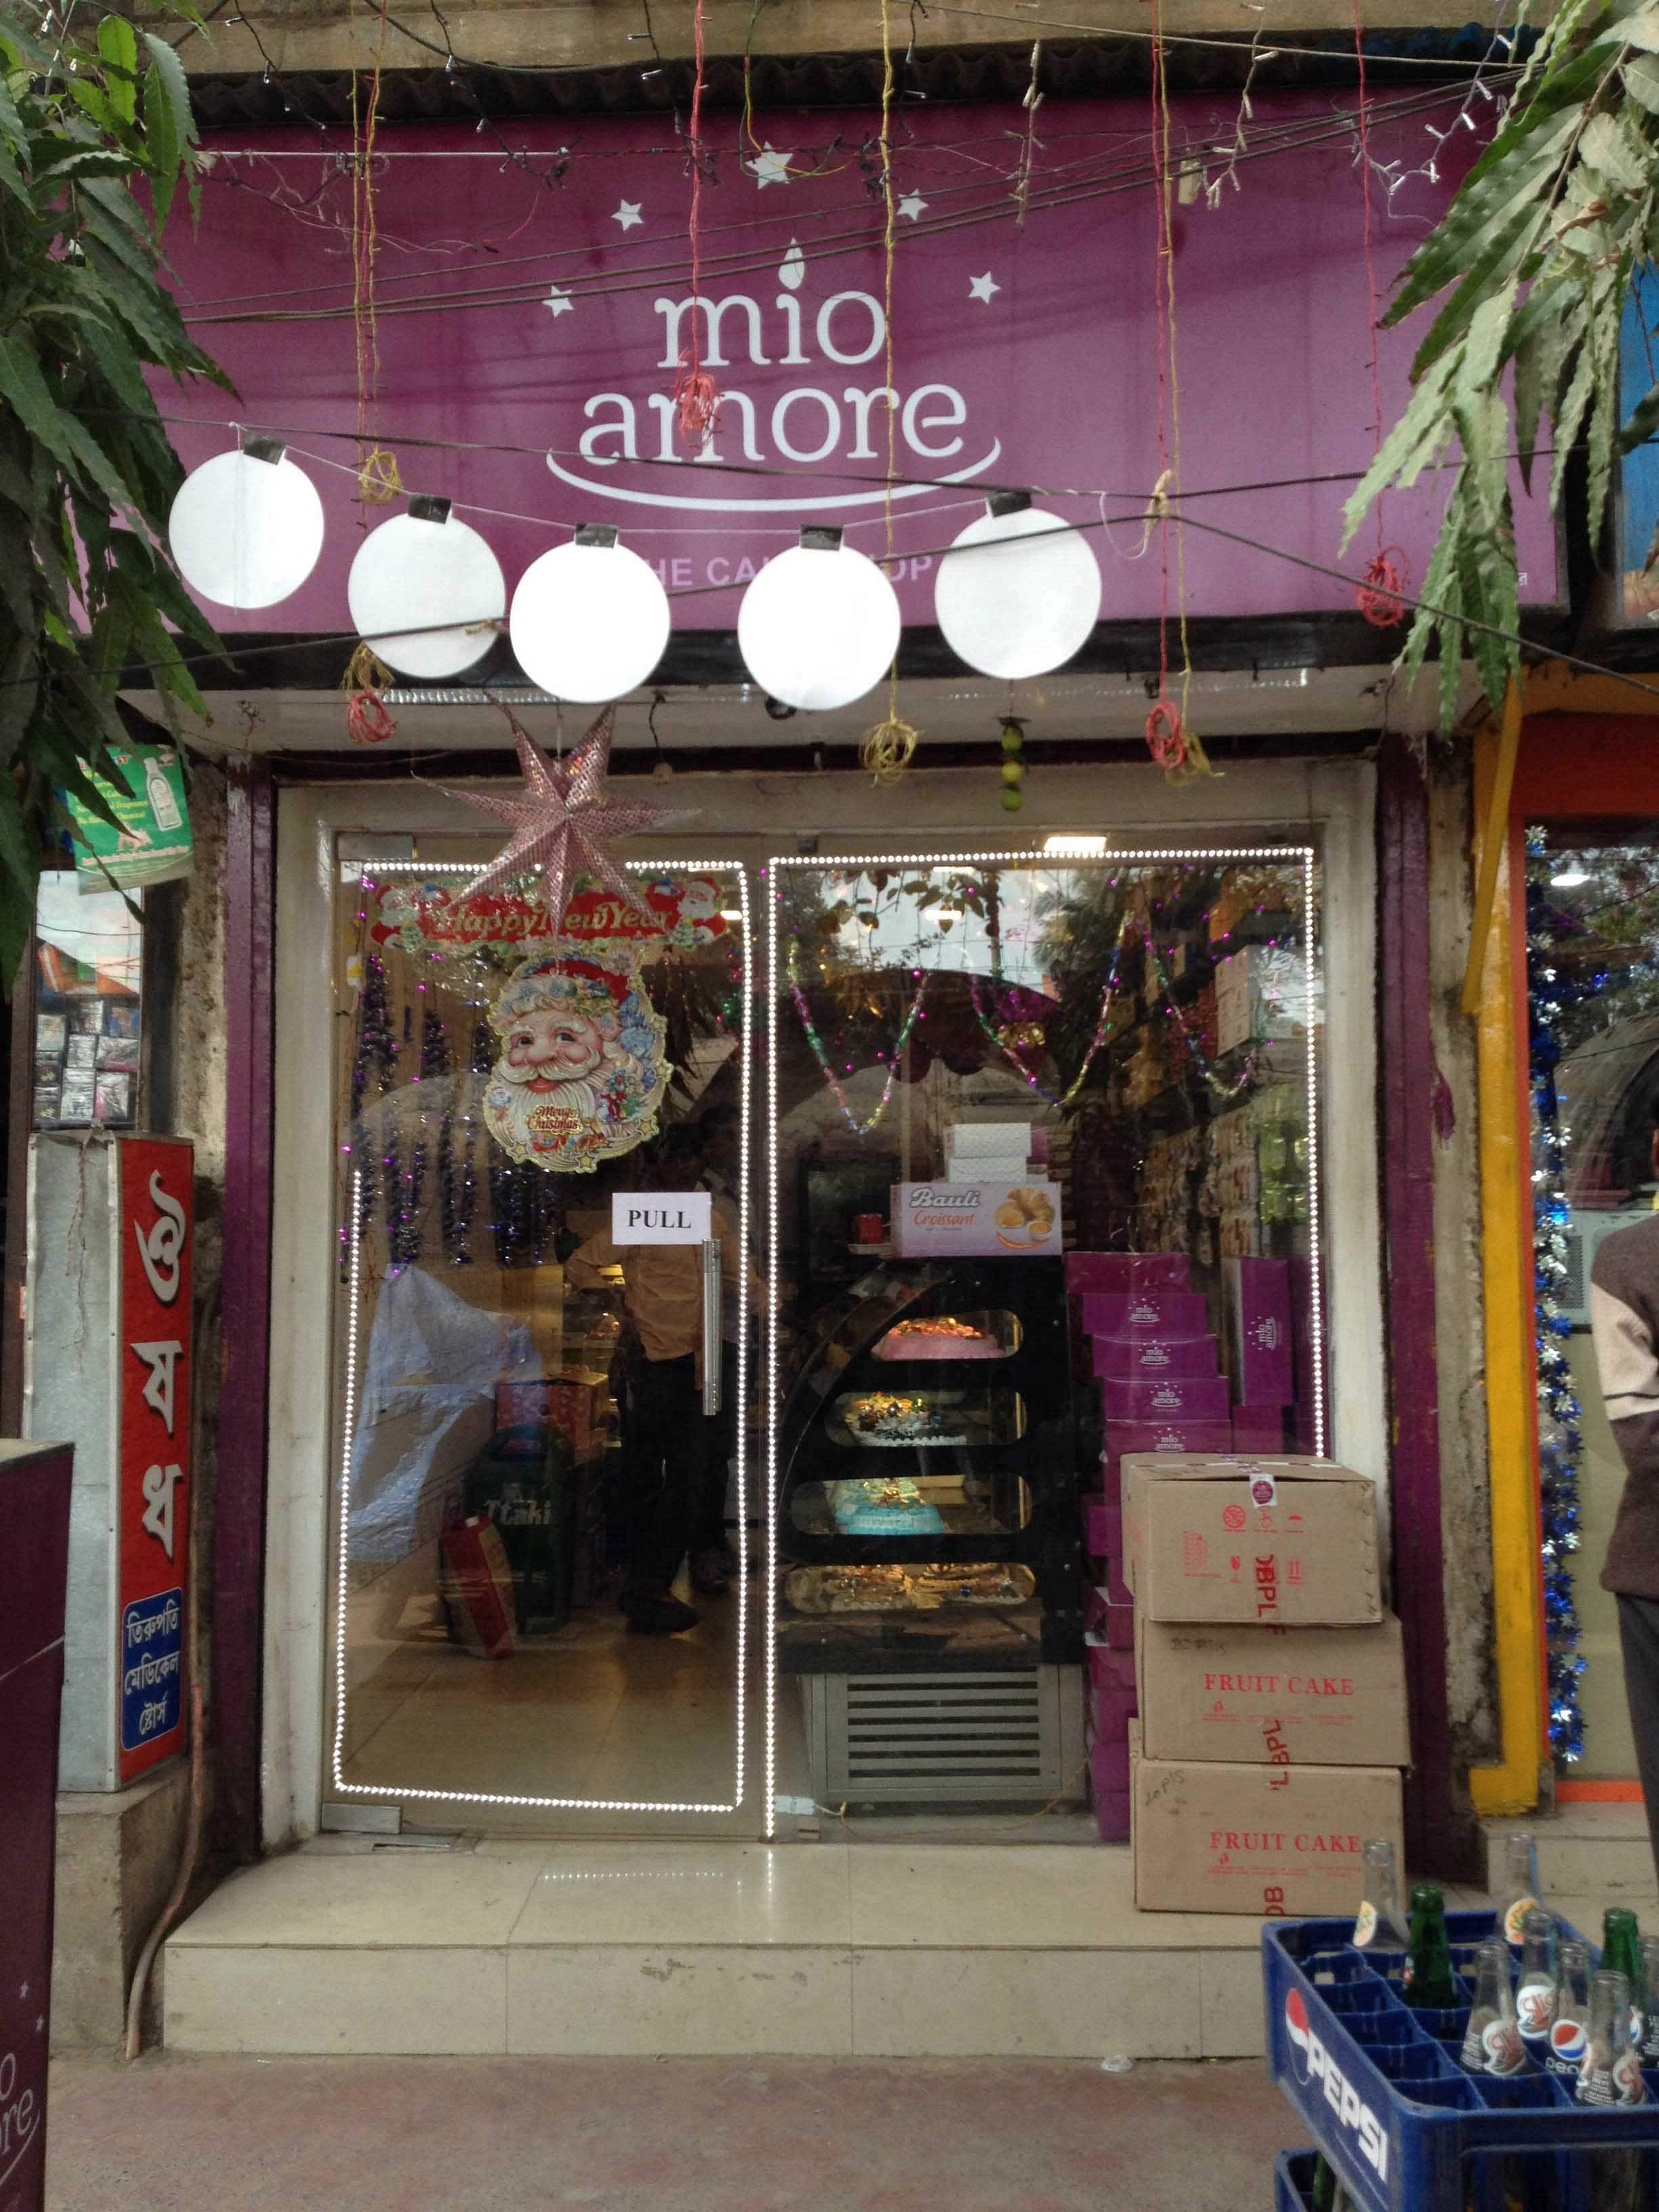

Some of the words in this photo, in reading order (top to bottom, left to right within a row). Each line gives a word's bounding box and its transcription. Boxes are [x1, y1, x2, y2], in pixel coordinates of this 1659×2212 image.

[654, 238, 886, 368] mio
[909, 1187, 981, 1208] Bauli
[628, 1209, 691, 1229] PULL
[1204, 1673, 1279, 1693] FRUIT
[1288, 1676, 1355, 1696] CAKE
[1210, 1831, 1286, 1851] FRUIT
[1294, 1834, 1361, 1854] CAKE
[1307, 2028, 1388, 2185] PEPSI
